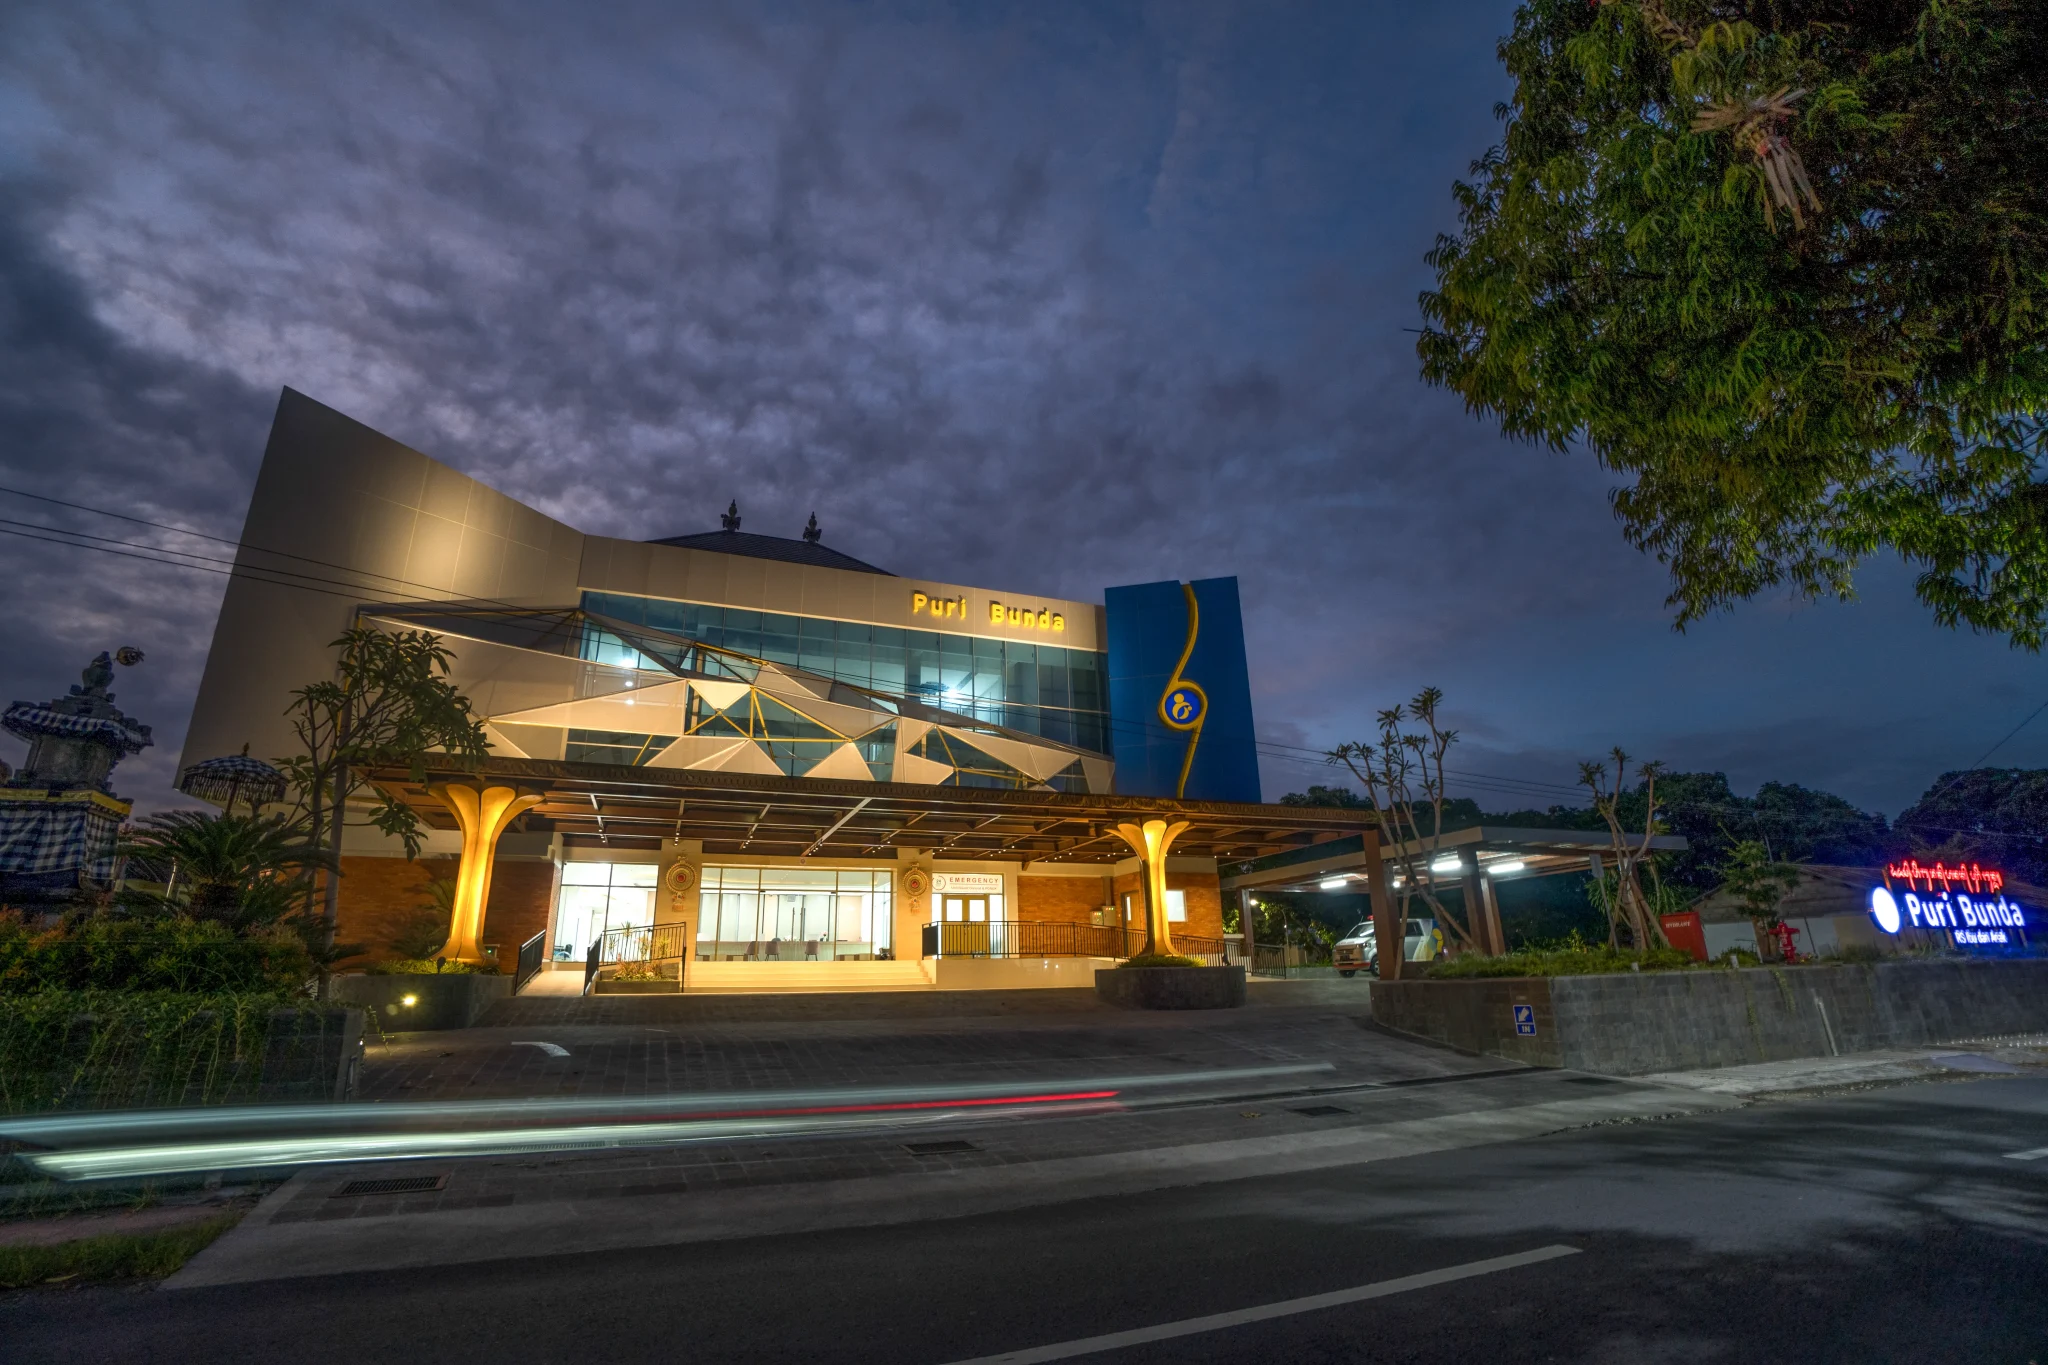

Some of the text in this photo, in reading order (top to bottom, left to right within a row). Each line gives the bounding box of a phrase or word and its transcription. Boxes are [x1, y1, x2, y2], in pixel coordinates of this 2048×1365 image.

[912, 593, 1065, 631] Puri Bunda
[1905, 892, 2025, 927] Puri Bunda
[1954, 929, 1966, 944] RS
[1521, 1025, 1531, 1033] IN
